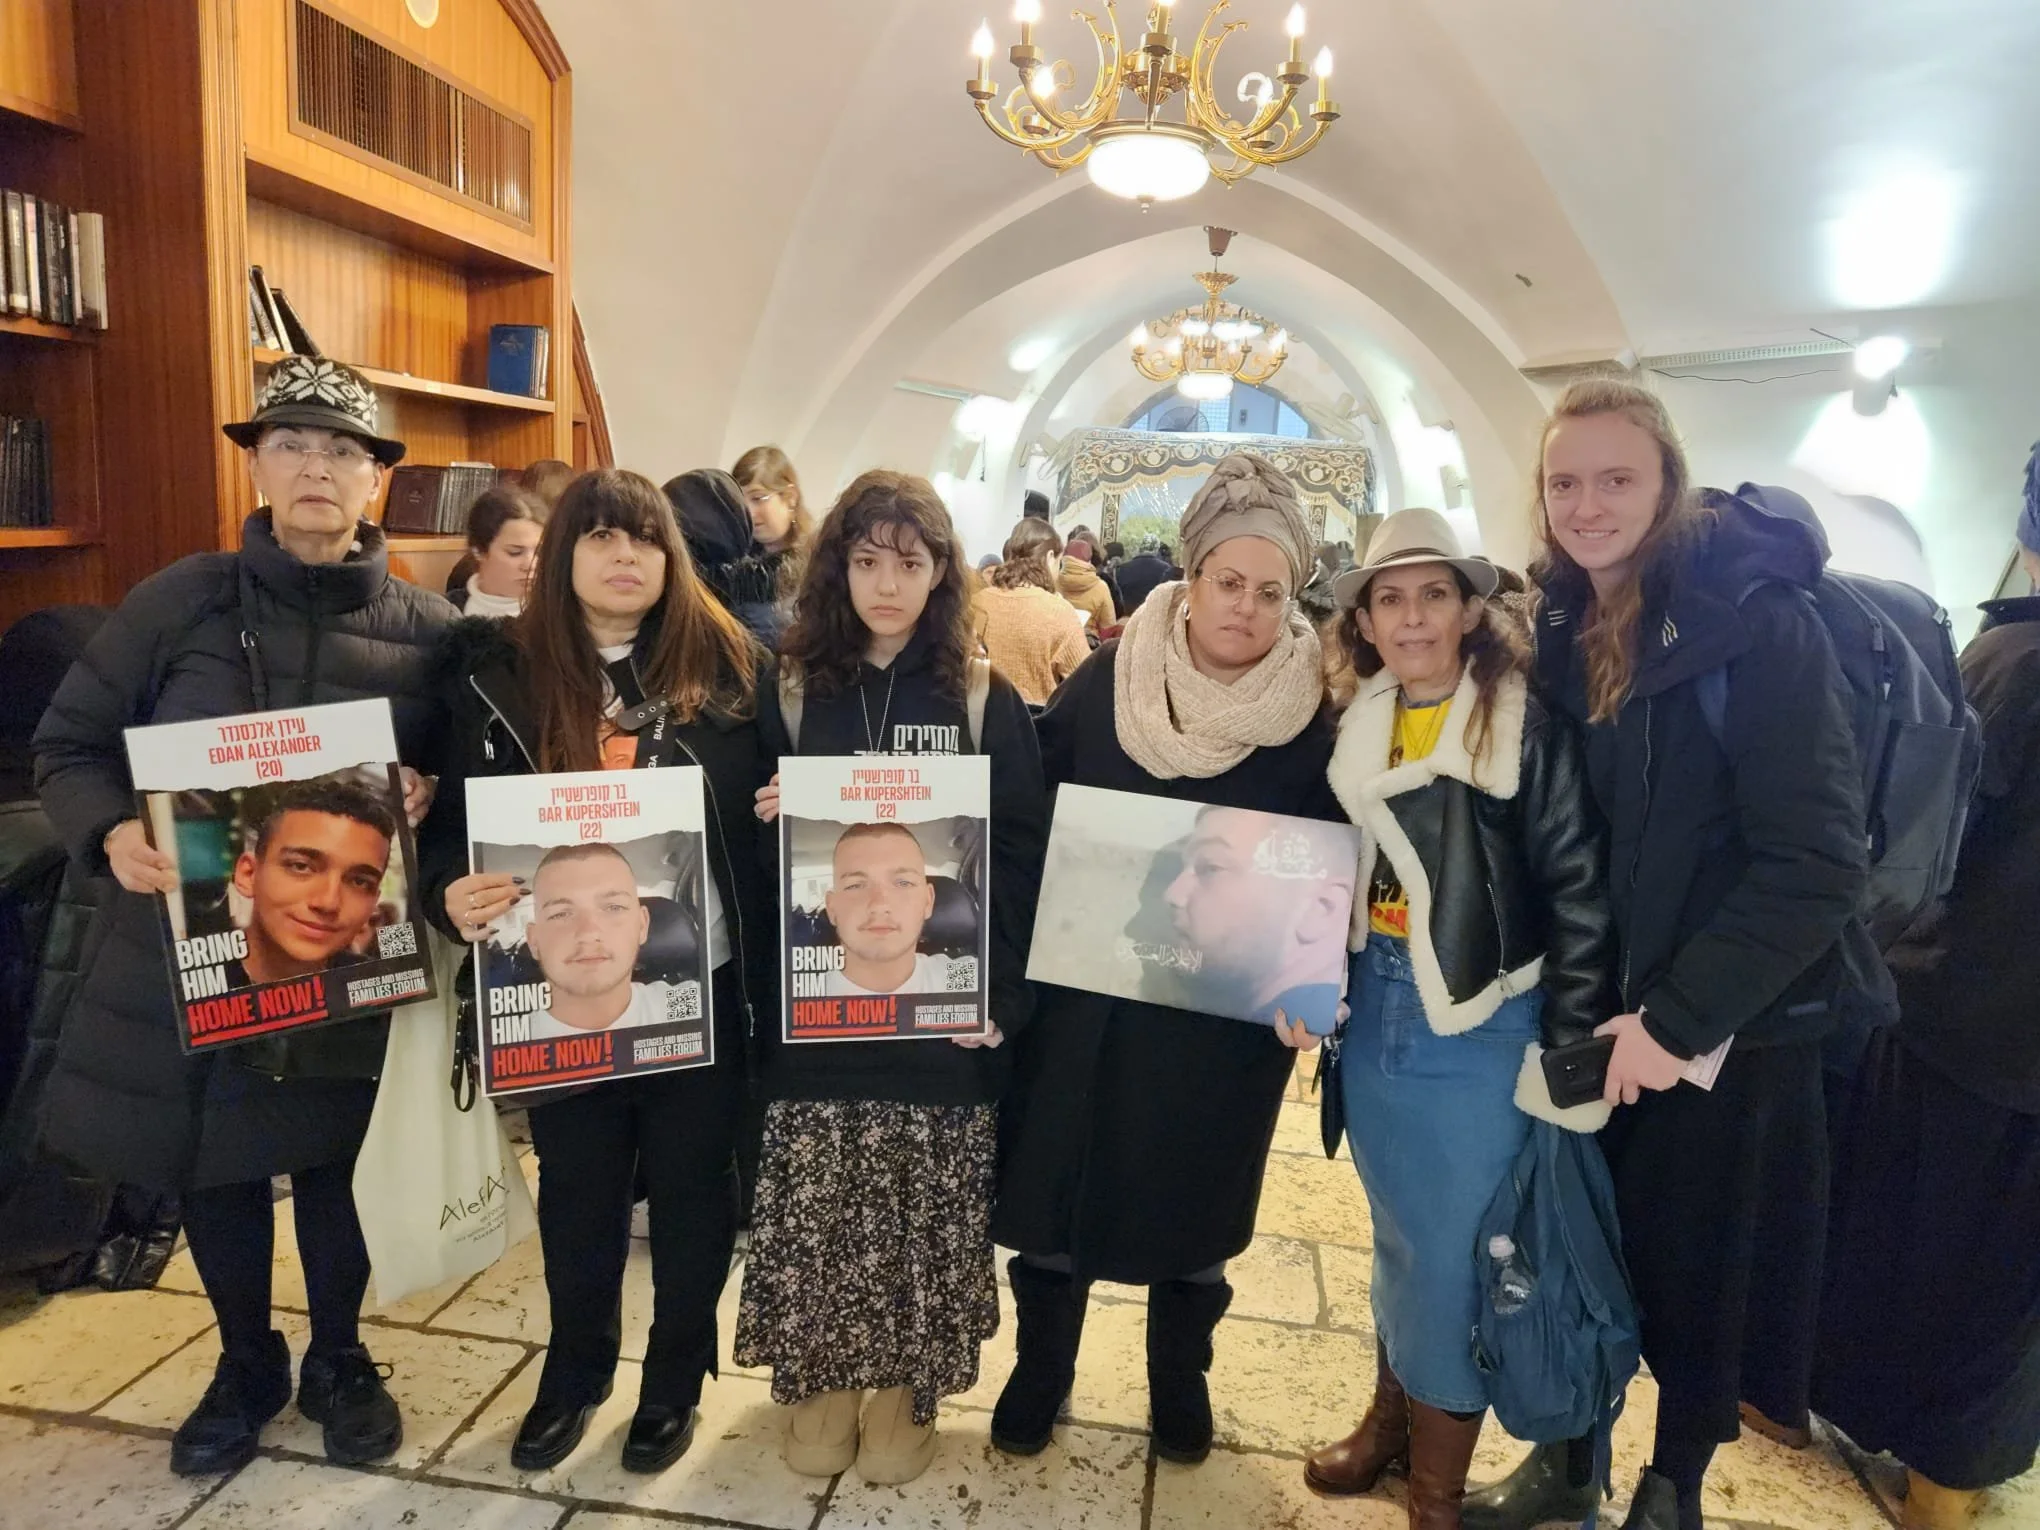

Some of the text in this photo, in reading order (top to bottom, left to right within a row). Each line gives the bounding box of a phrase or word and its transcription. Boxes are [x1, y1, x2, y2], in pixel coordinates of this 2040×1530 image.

[218, 717, 306, 743] עידן אלכסנדר
[894, 724, 960, 752] מחזירים
[208, 735, 322, 765] EDAN ALEXANDER
[256, 758, 283, 779] (20)
[852, 769, 920, 786] בר קופרשטיין
[551, 783, 627, 806] בר קופרשטיין
[840, 786, 932, 801] BAR KUPERSHTEIN
[538, 801, 641, 823] BAR KUPERSHTEIN
[876, 802, 897, 819] (22)
[580, 821, 602, 840] (22)
[175, 929, 249, 971] BRING
[792, 945, 845, 971] BRING
[180, 964, 229, 1002] HIM
[347, 967, 425, 992] HOSTAGES AND MISSING
[349, 977, 427, 1005] FAMILIES FORUM
[792, 972, 827, 997] HIM
[187, 975, 326, 1036] HOME NOW!
[489, 982, 552, 1016] BRING
[793, 995, 898, 1026] HOME NOW!
[943, 1004, 954, 1013] AND
[954, 1003, 978, 1013] MISSING
[491, 1013, 531, 1046] HIM
[915, 1012, 978, 1025] FAMILIES FORUM
[634, 1040, 703, 1061] FAMILIES FORUM
[664, 1035, 676, 1045] AND
[676, 1031, 703, 1043] MISSING
[492, 1031, 614, 1077] HOME NOW!
